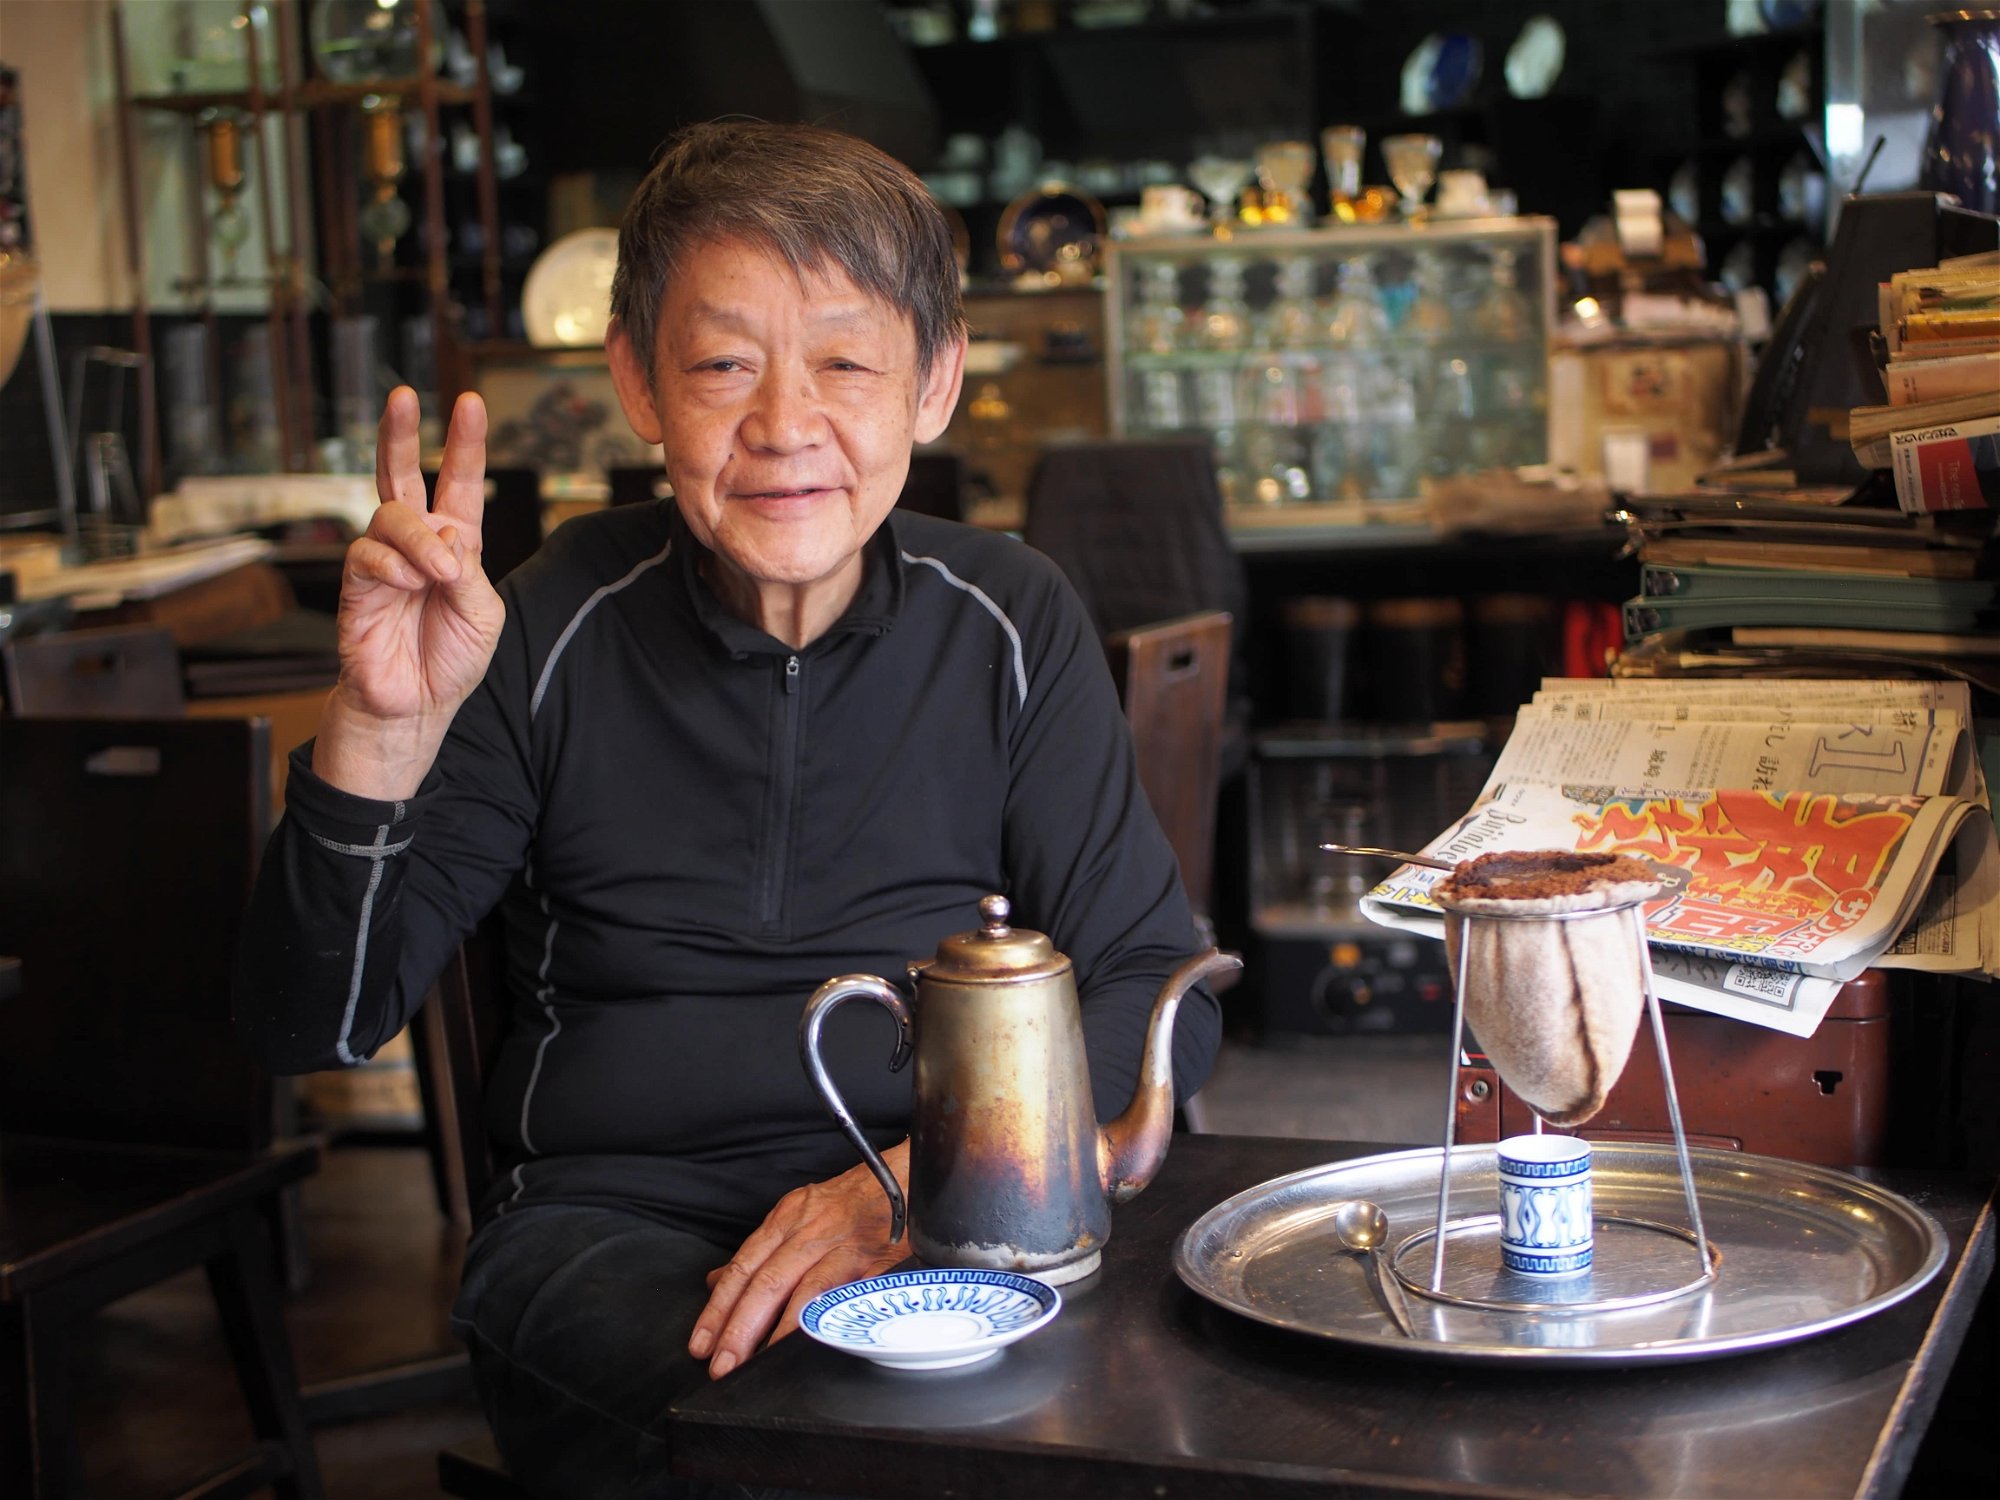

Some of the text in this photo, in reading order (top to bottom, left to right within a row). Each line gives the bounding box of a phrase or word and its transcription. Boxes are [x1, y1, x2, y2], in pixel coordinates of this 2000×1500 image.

[1436, 808, 1528, 862] Buffaloe
[1780, 896, 1869, 952] サンスポ
